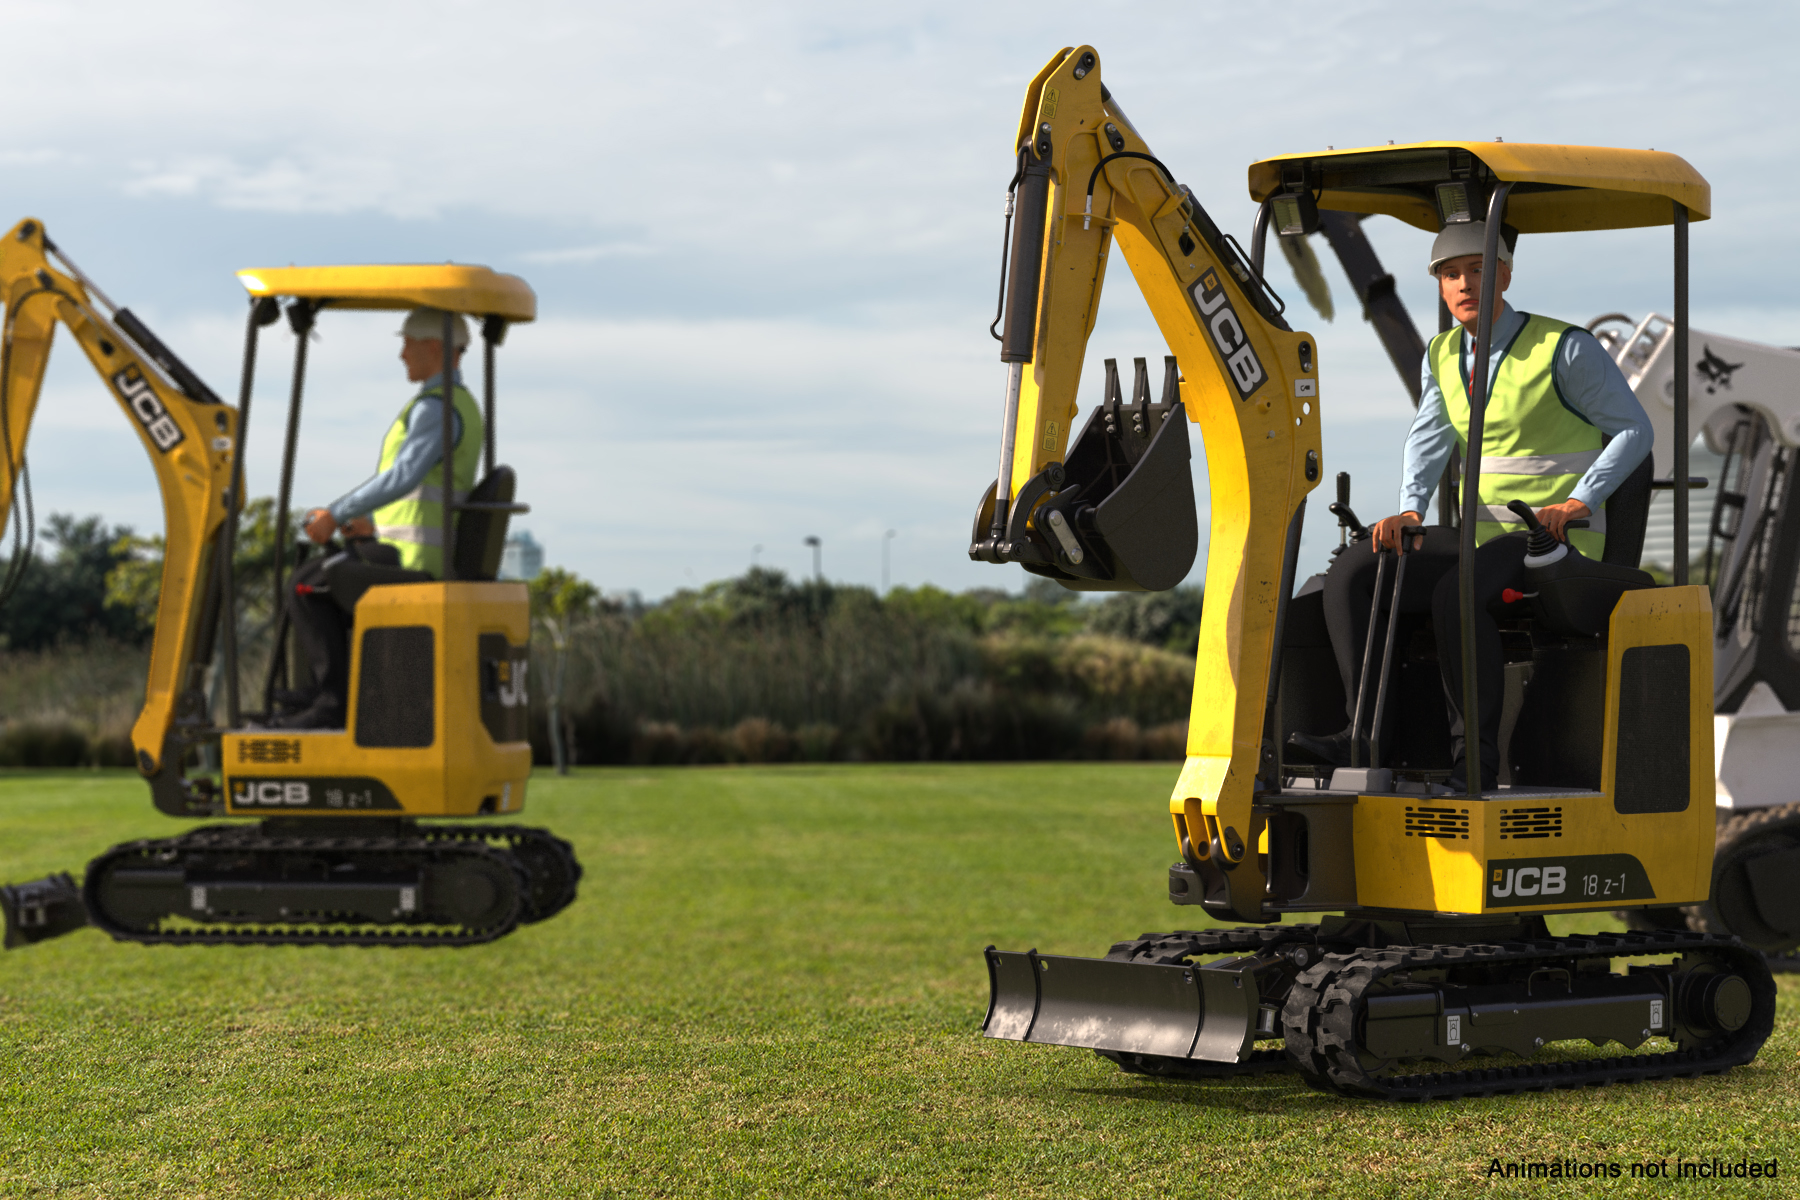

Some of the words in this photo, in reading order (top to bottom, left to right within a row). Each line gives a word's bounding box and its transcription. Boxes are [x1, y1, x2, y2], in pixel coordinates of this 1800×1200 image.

[1194, 283, 1262, 393] JCB
[116, 373, 181, 449] JCB
[234, 781, 310, 805] JCB
[1492, 866, 1567, 898] JCB
[1582, 874, 1599, 896] 18
